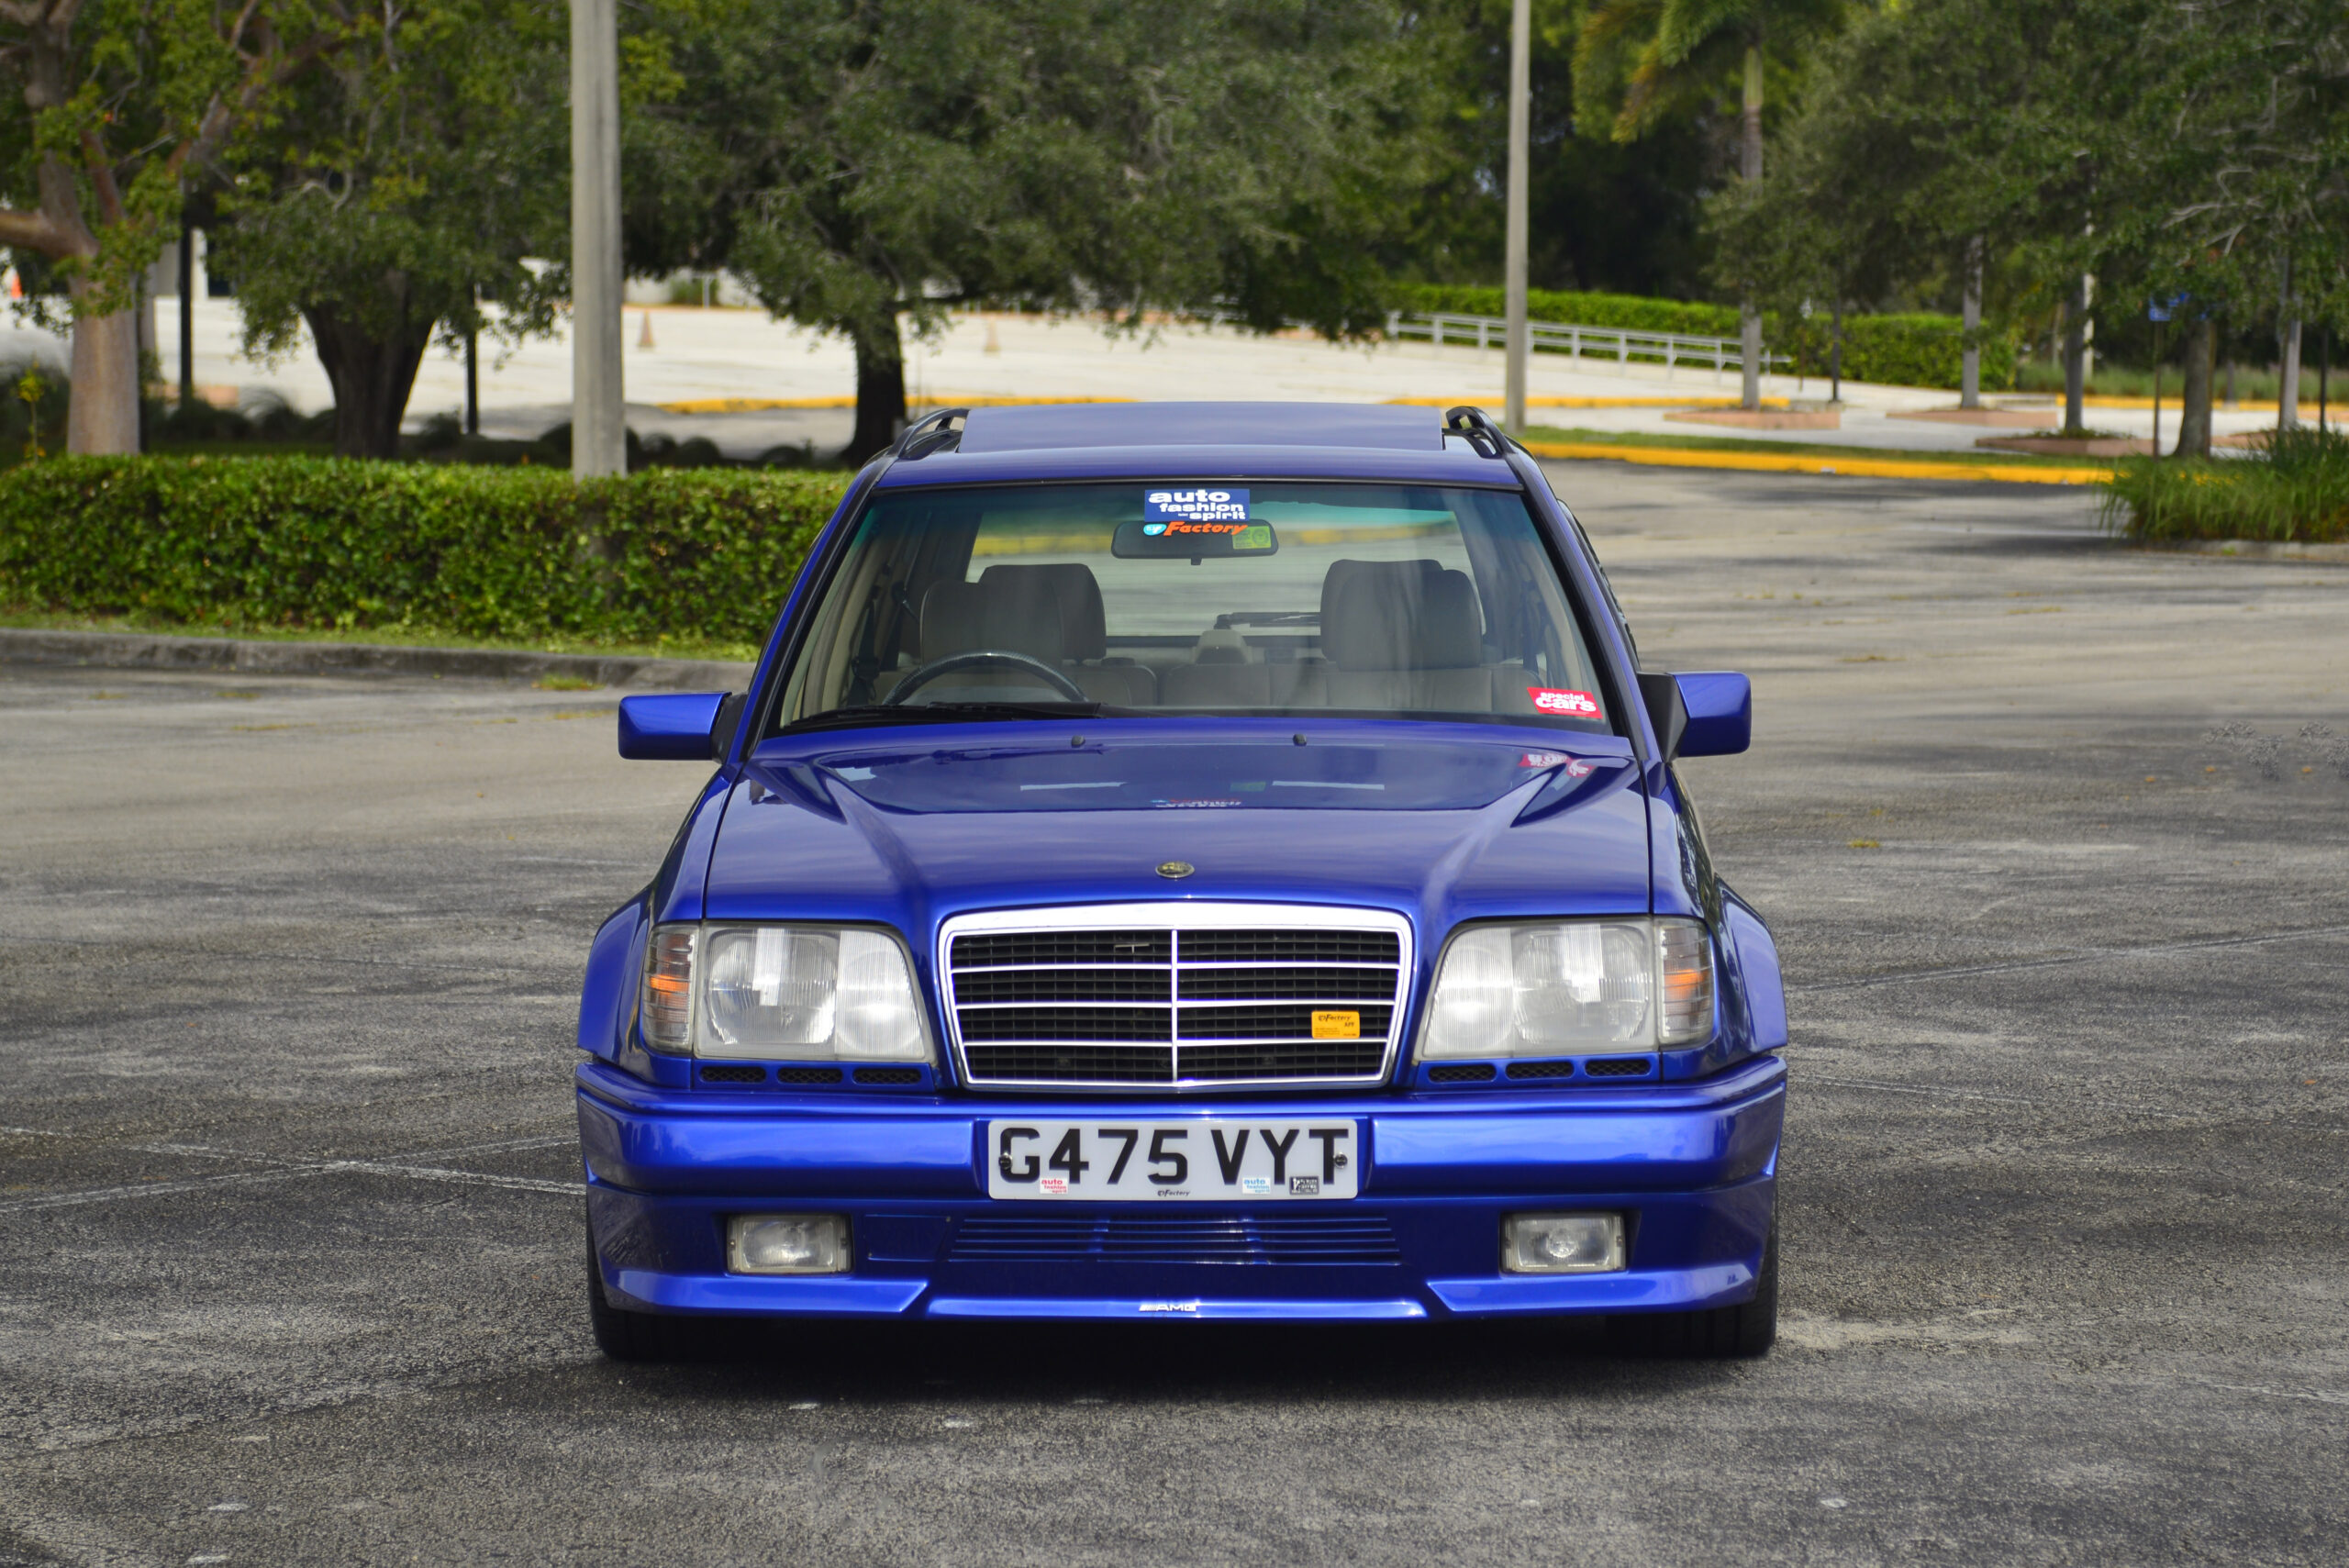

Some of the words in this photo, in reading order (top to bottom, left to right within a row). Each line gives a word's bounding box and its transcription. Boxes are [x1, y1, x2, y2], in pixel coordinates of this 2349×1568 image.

[1149, 489, 1230, 503] auto
[1159, 502, 1244, 513] fashion
[1189, 511, 1246, 521] spirit
[1163, 520, 1248, 536] Factory
[1540, 692, 1586, 702] special
[1535, 696, 1597, 712] cars
[999, 1128, 1188, 1185] G475
[1210, 1129, 1349, 1185] VYT
[1156, 1303, 1197, 1312] AMG
